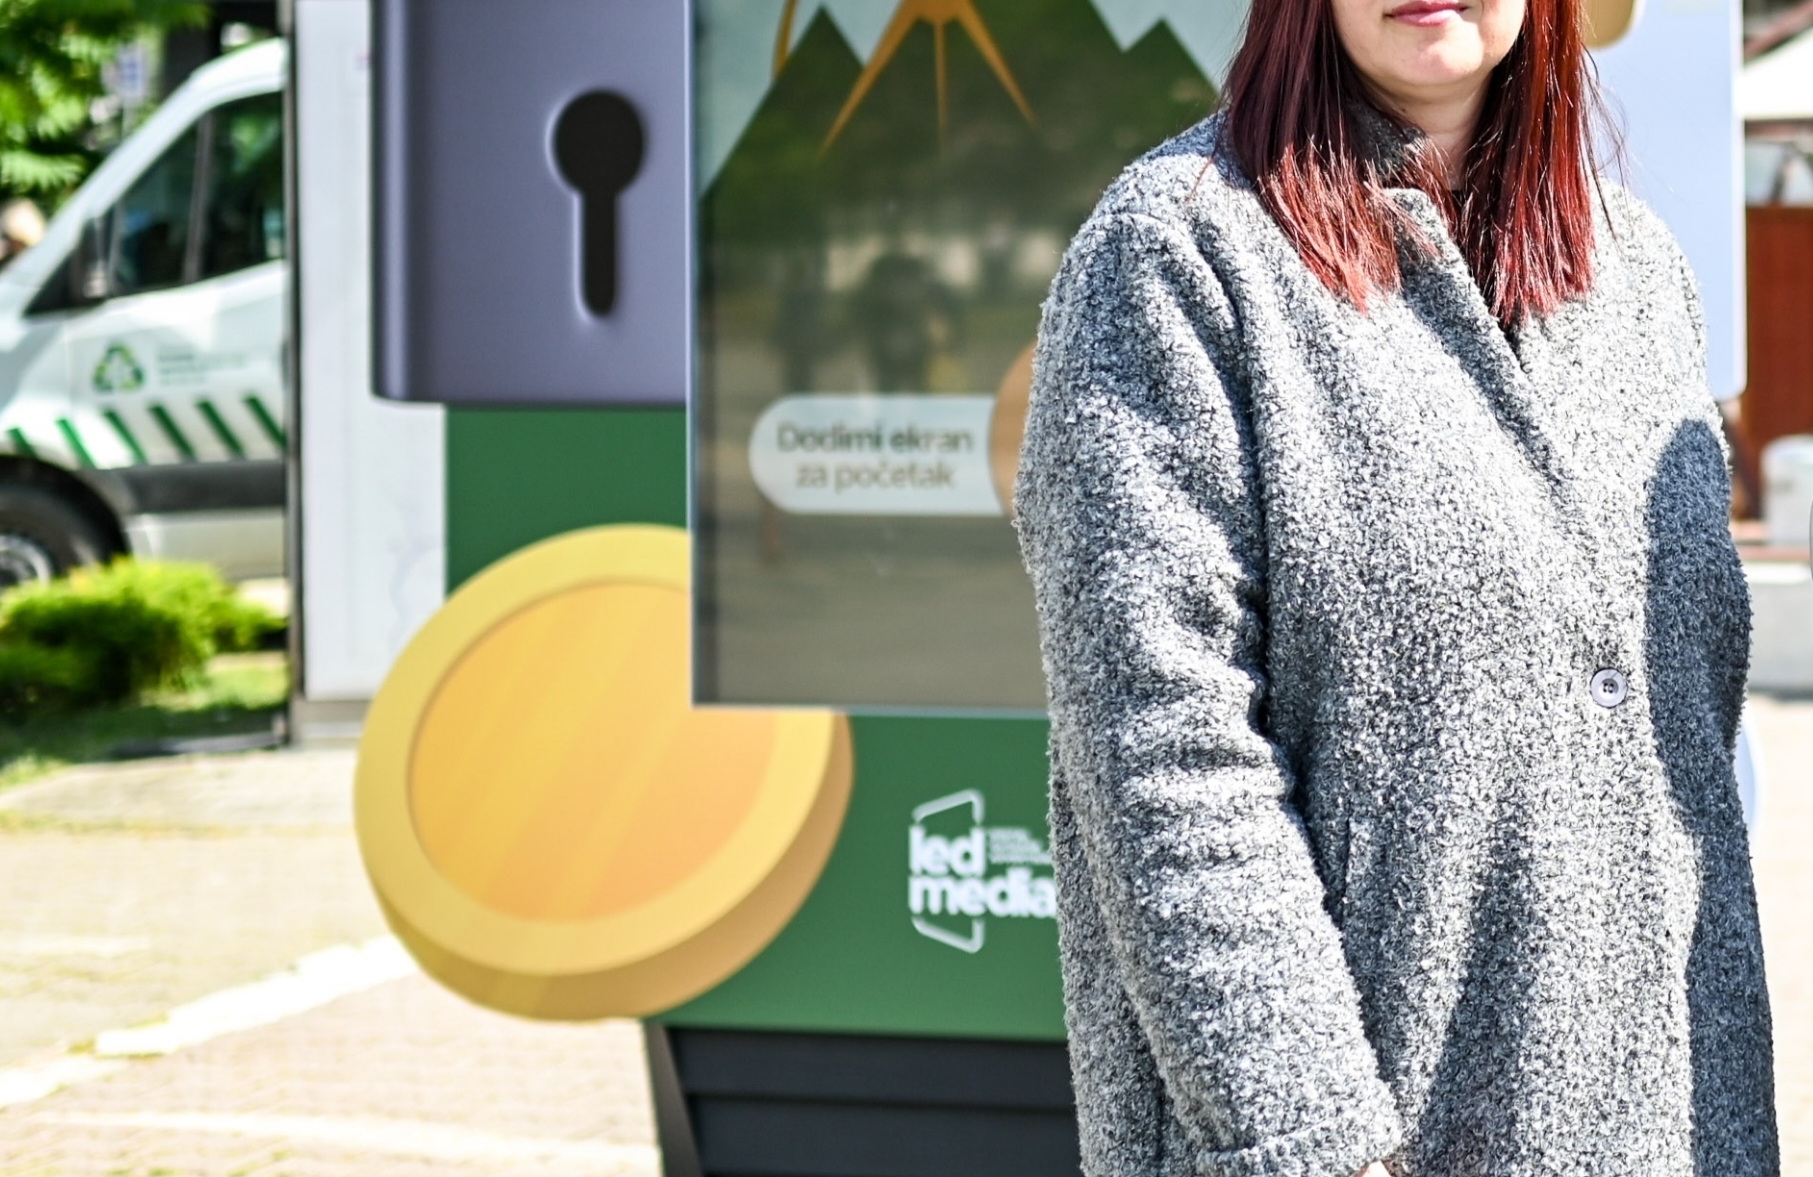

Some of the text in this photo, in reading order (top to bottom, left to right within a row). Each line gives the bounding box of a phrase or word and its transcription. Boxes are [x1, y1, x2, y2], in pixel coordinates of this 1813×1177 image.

[890, 422, 974, 453] ekran
[797, 465, 828, 488] za
[908, 824, 986, 876] led
[908, 867, 1057, 918] media
